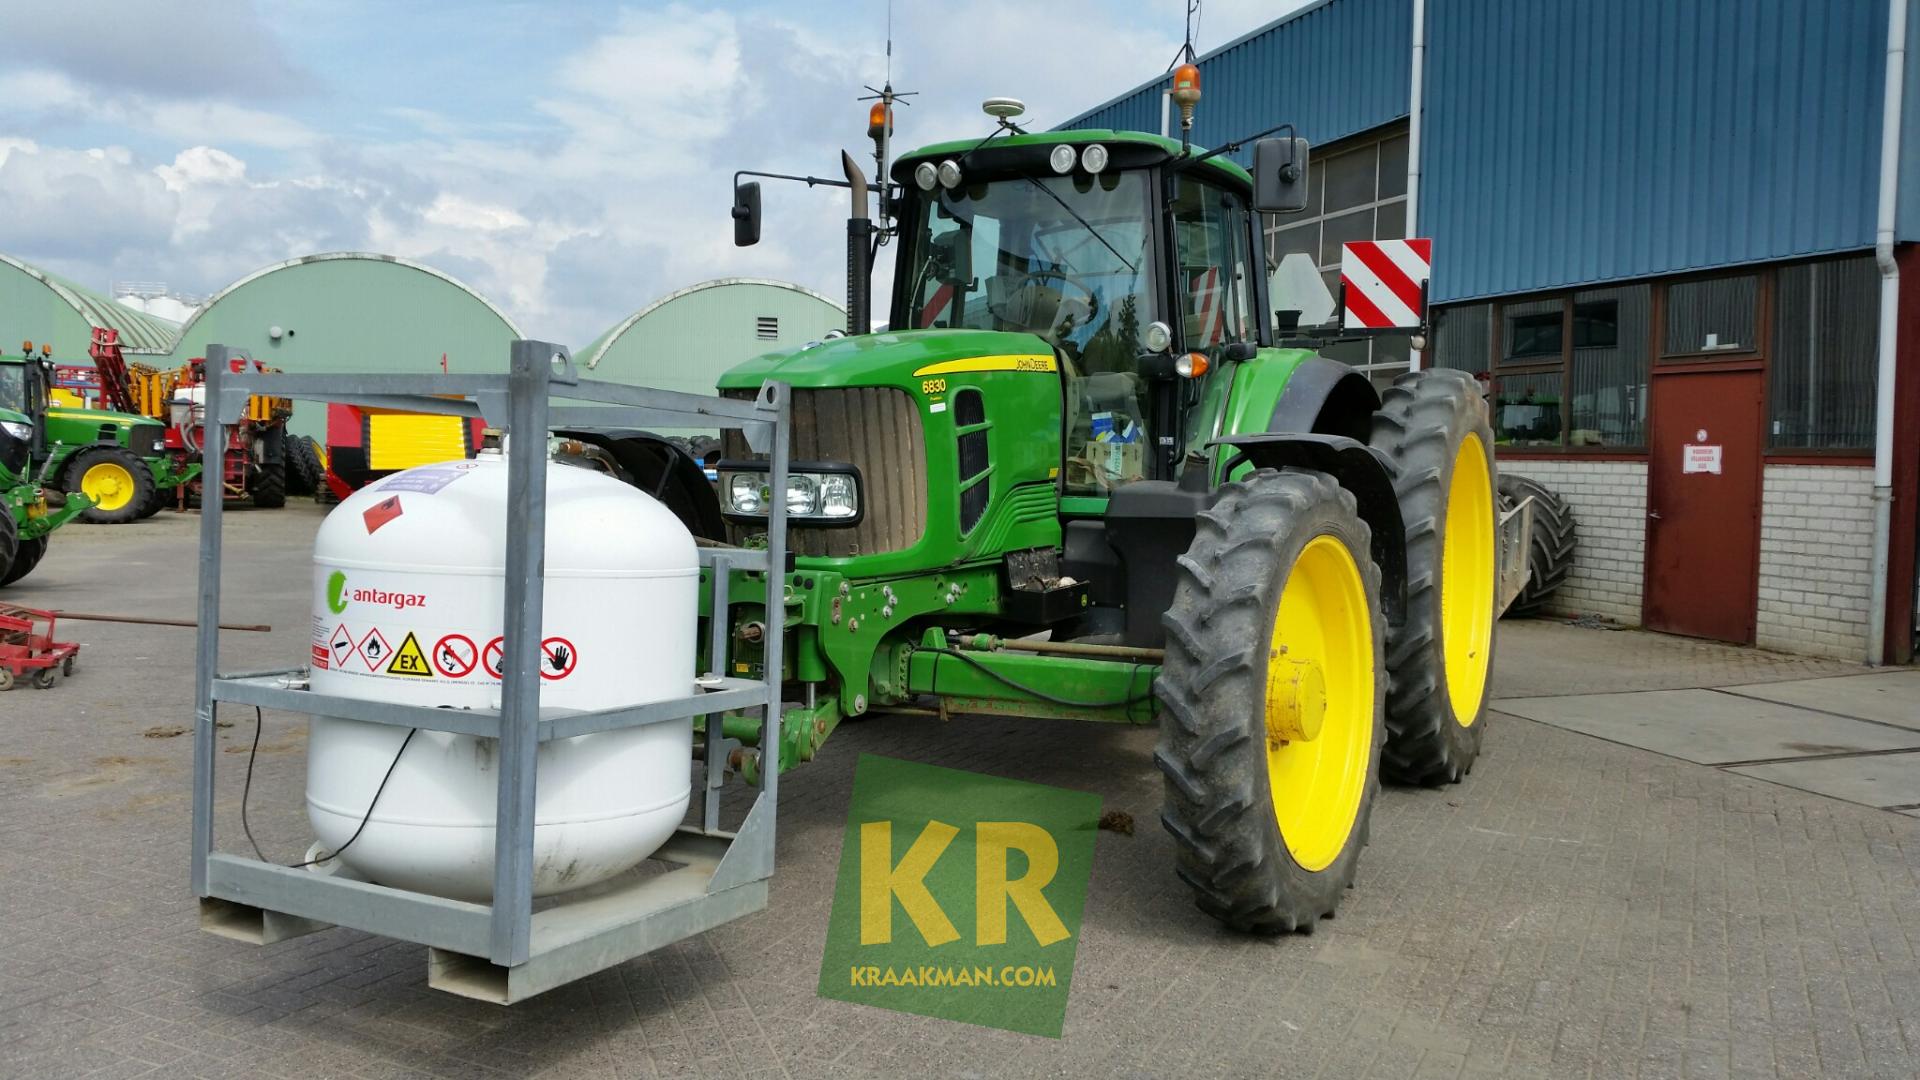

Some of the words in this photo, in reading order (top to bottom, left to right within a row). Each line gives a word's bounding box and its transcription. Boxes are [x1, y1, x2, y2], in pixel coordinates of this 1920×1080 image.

[922, 378, 946, 394] 6830
[353, 588, 427, 610] antargaz
[400, 655, 419, 671] EX
